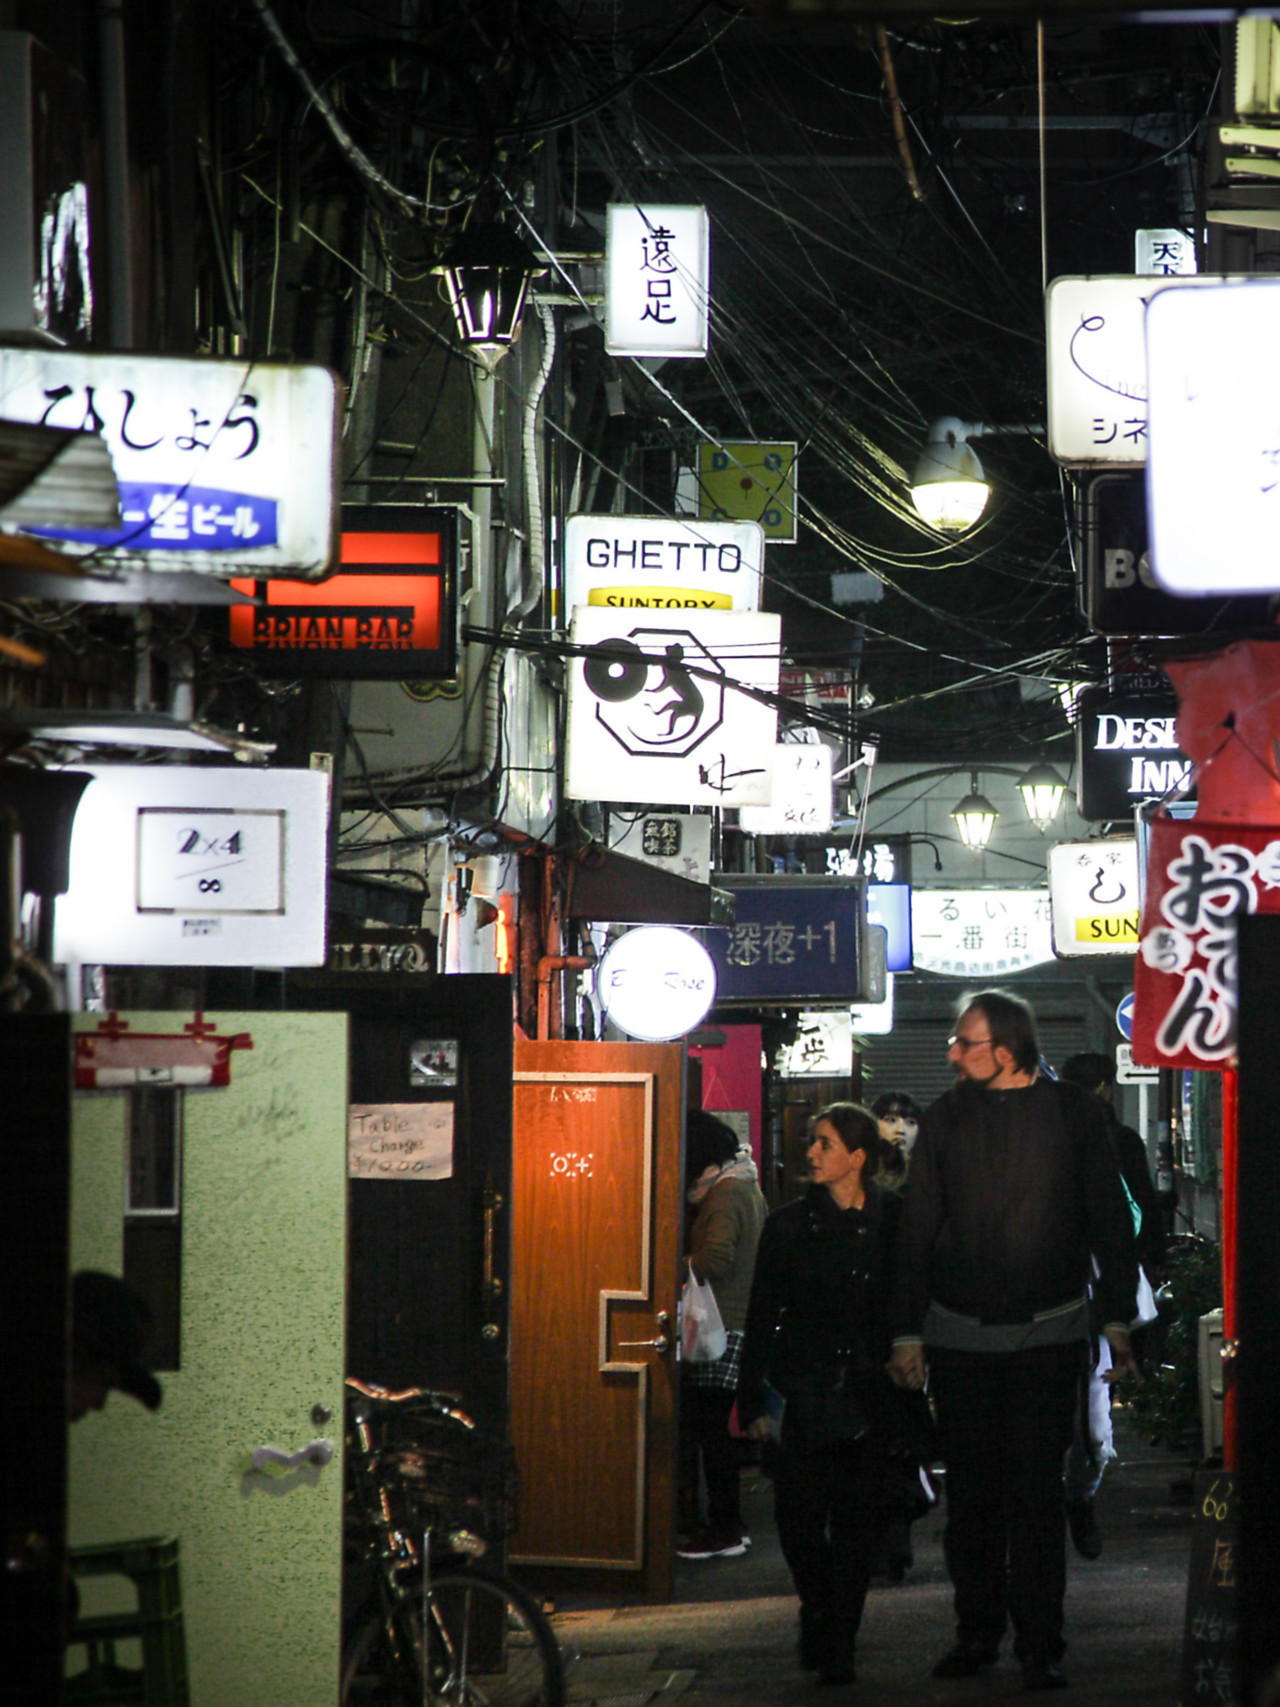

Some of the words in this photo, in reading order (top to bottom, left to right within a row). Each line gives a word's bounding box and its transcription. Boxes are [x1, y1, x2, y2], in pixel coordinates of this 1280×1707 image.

[640, 225, 677, 324] 遠足
[586, 538, 742, 573] GHETTO
[254, 617, 344, 650] BRIAN
[357, 617, 415, 650] BAR
[353, 1113, 413, 1134] Table
